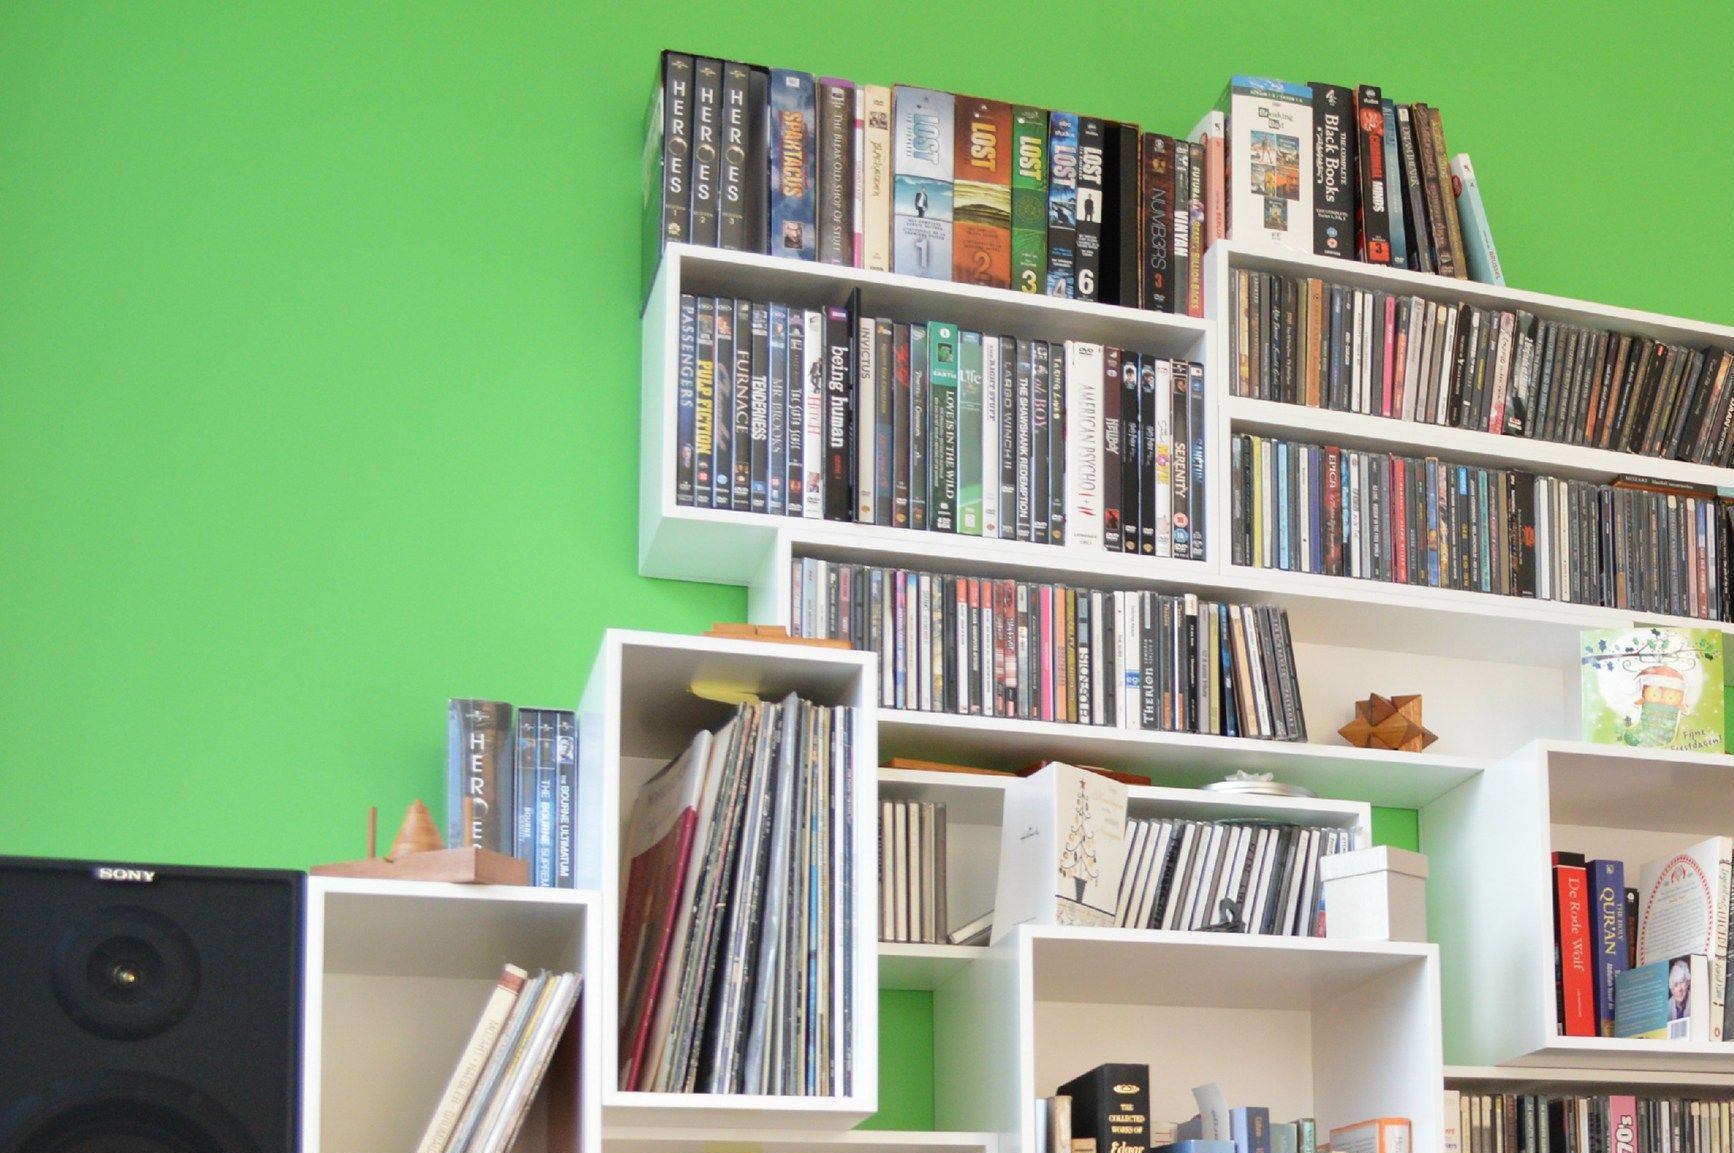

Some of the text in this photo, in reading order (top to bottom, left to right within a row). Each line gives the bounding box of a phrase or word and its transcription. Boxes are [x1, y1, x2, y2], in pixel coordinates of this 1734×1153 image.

[669, 81, 687, 193] HEROES
[1258, 107, 1293, 122] Breaking
[1325, 113, 1339, 153] Black
[697, 88, 715, 200] HEROES
[726, 90, 745, 201] HEROES
[783, 111, 803, 197] SPARTACUS
[914, 114, 939, 165] LOST
[971, 123, 996, 172] LOST
[1020, 136, 1042, 181] LOST
[1053, 145, 1076, 189] LOST
[1082, 147, 1102, 185] LOST
[1325, 157, 1339, 202] Books
[915, 239, 927, 268] 1
[1174, 210, 1188, 257] VINYAN
[1022, 270, 1037, 294] 3
[1079, 269, 1094, 294] 6
[681, 305, 695, 408] PASSENGERS
[861, 327, 871, 379] INVICTUS
[696, 359, 712, 455] PULP FICTION
[735, 350, 749, 434] FURNACE
[751, 376, 766, 440] TENDERNESS
[829, 346, 848, 448] being human
[944, 390, 954, 420] LOVE
[1003, 361, 1013, 408] LARGO
[945, 444, 954, 468] THE
[1003, 413, 1013, 460] WINCH
[1019, 378, 1029, 518] THE SHAWSHANK REDEMPTION
[1078, 384, 1096, 491] AMERICAN PSYCHO
[1106, 418, 1119, 455] HELLBOY
[945, 470, 955, 499] WILD
[1173, 442, 1189, 499] SERENITY
[1328, 454, 1336, 488] EPICA
[541, 780, 550, 799] THE
[540, 801, 551, 846] BOURNE
[560, 785, 570, 877] BOURNE ULTIMATUM
[98, 867, 155, 882] SONY
[1568, 877, 1585, 972] De Rode Wolf
[1600, 887, 1617, 955] QUR'AN
[1108, 1114, 1145, 1123] COLLECTED
